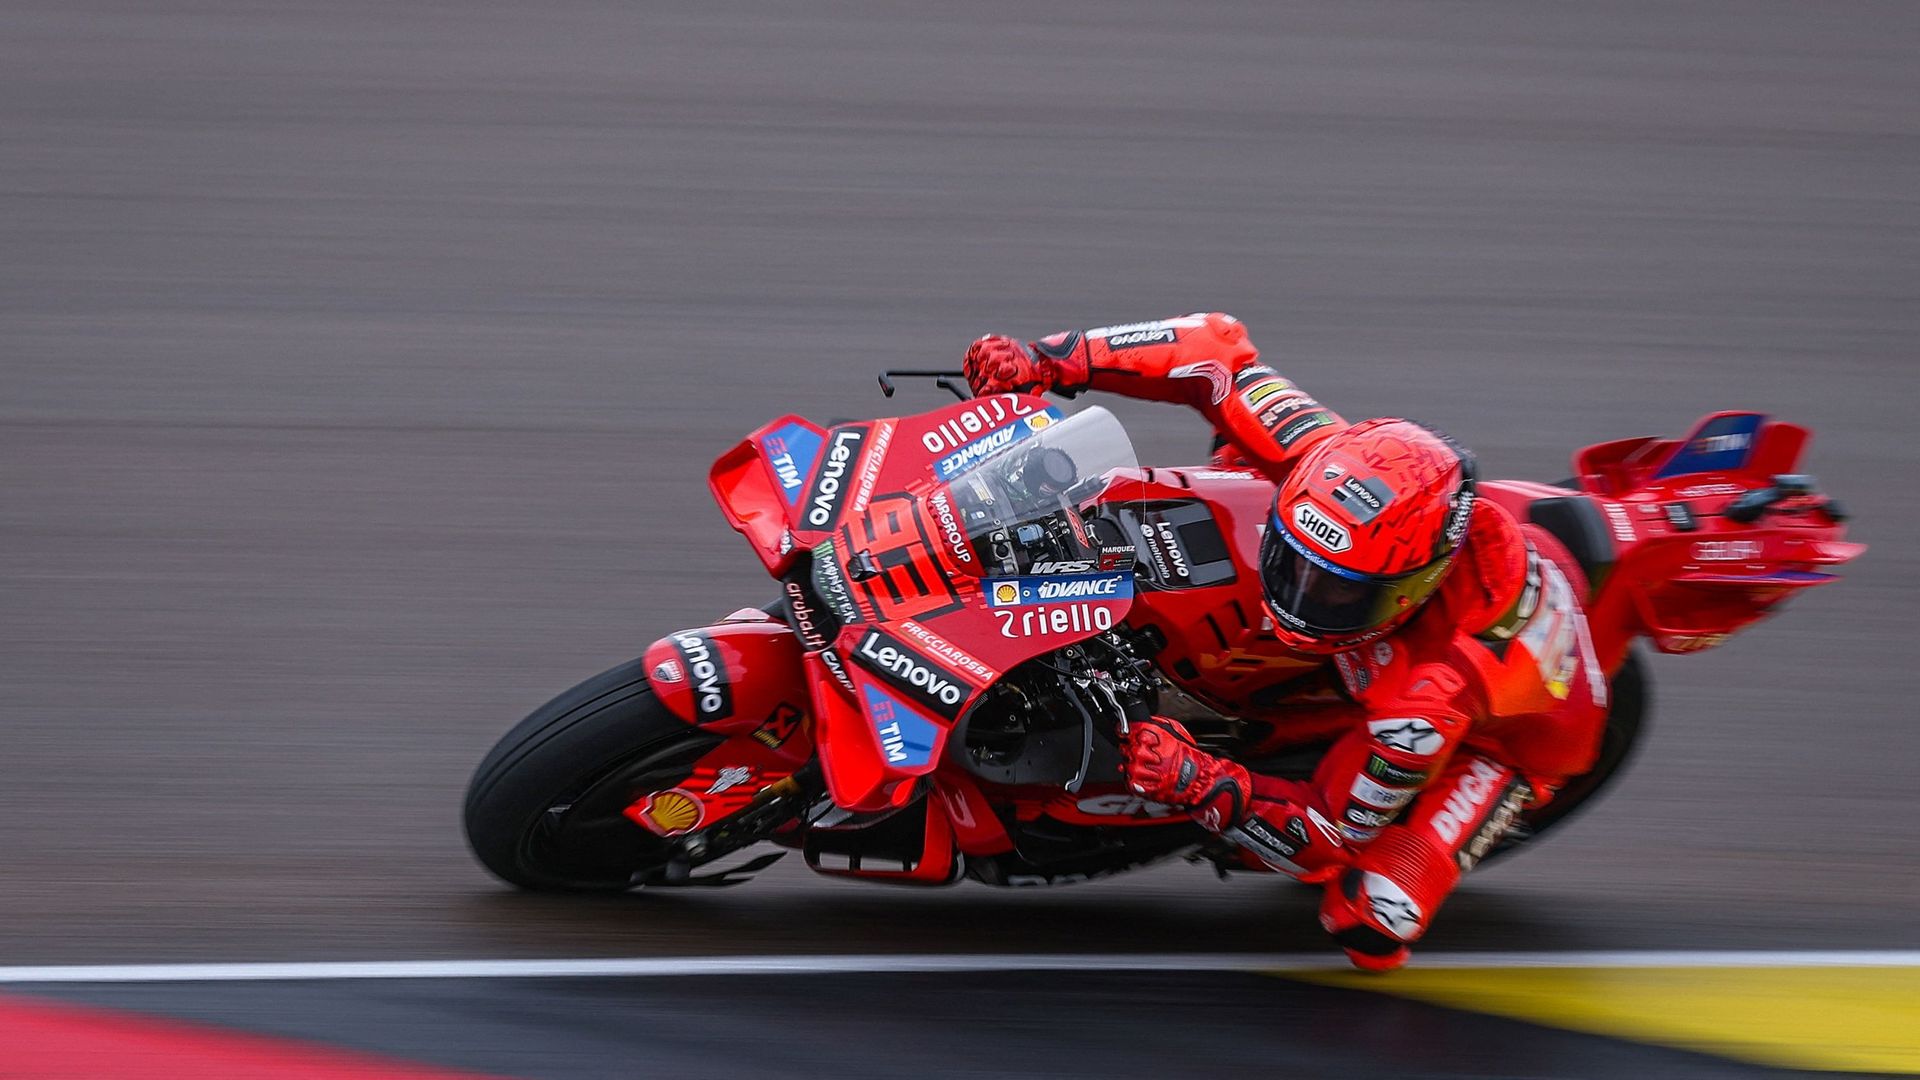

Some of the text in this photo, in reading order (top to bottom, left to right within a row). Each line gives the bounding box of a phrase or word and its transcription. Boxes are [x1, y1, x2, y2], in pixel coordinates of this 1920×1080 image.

[1110, 329, 1175, 345] Lenovo
[772, 452, 802, 490] TIM
[852, 422, 893, 512] FRECCIAROSSA
[942, 423, 1016, 476] ADVANCE
[809, 431, 861, 526] Lenovo
[1345, 478, 1380, 508] Lenovo
[1101, 545, 1135, 554] MARQUEZ
[1157, 521, 1189, 578] Lenovo
[1298, 508, 1343, 548] SHOEI
[821, 555, 857, 624] MONSTER
[1030, 560, 1096, 575] WRS
[786, 582, 827, 647] aruba.it
[673, 631, 722, 713] Lenovo
[861, 632, 961, 705] Lenovo
[901, 620, 995, 681] FRECCIAROSSA
[879, 722, 908, 763] TIM
